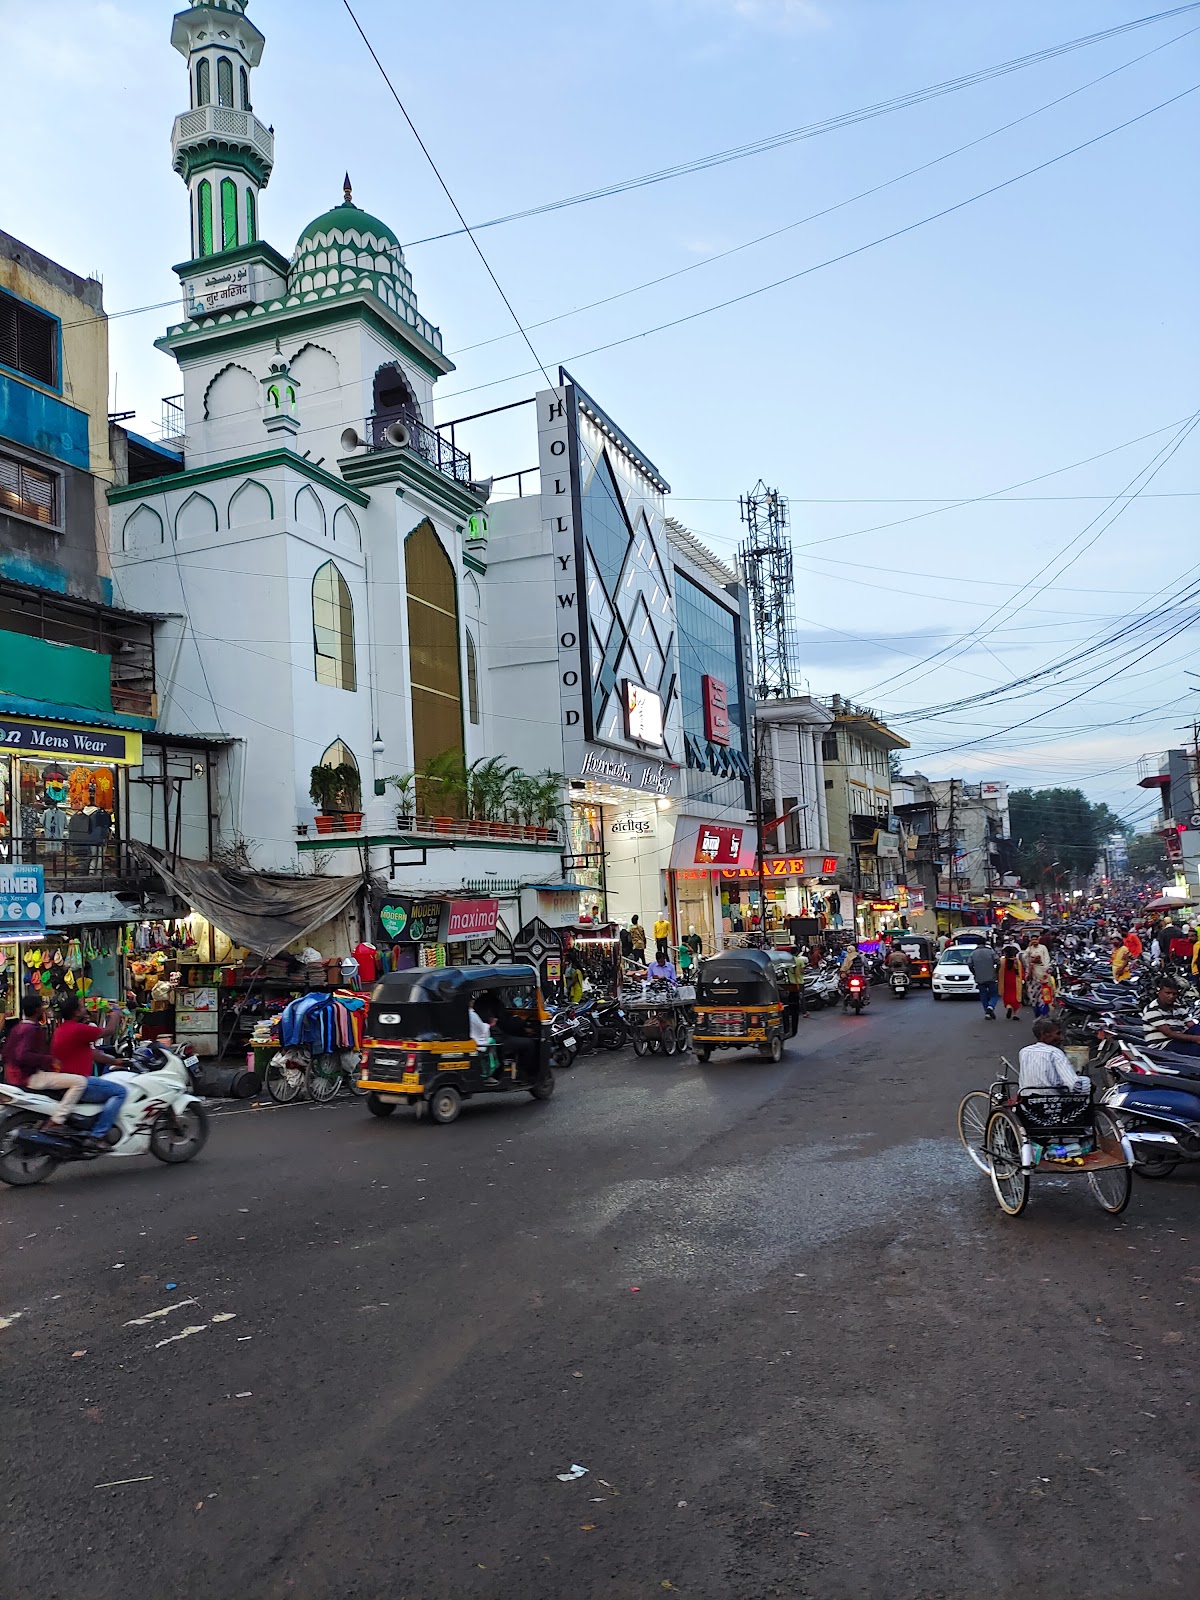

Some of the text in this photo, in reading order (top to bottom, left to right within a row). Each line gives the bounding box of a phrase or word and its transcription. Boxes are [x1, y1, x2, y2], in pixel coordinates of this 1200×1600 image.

[549, 399, 580, 726] HOLLYWOOD
[30, 730, 69, 749] Mens
[73, 735, 107, 752] Wear
[611, 819, 651, 833] हॉलीवुड
[380, 910, 408, 921] MODERN
[411, 904, 441, 919] MODERN
[450, 908, 496, 930] maxima
